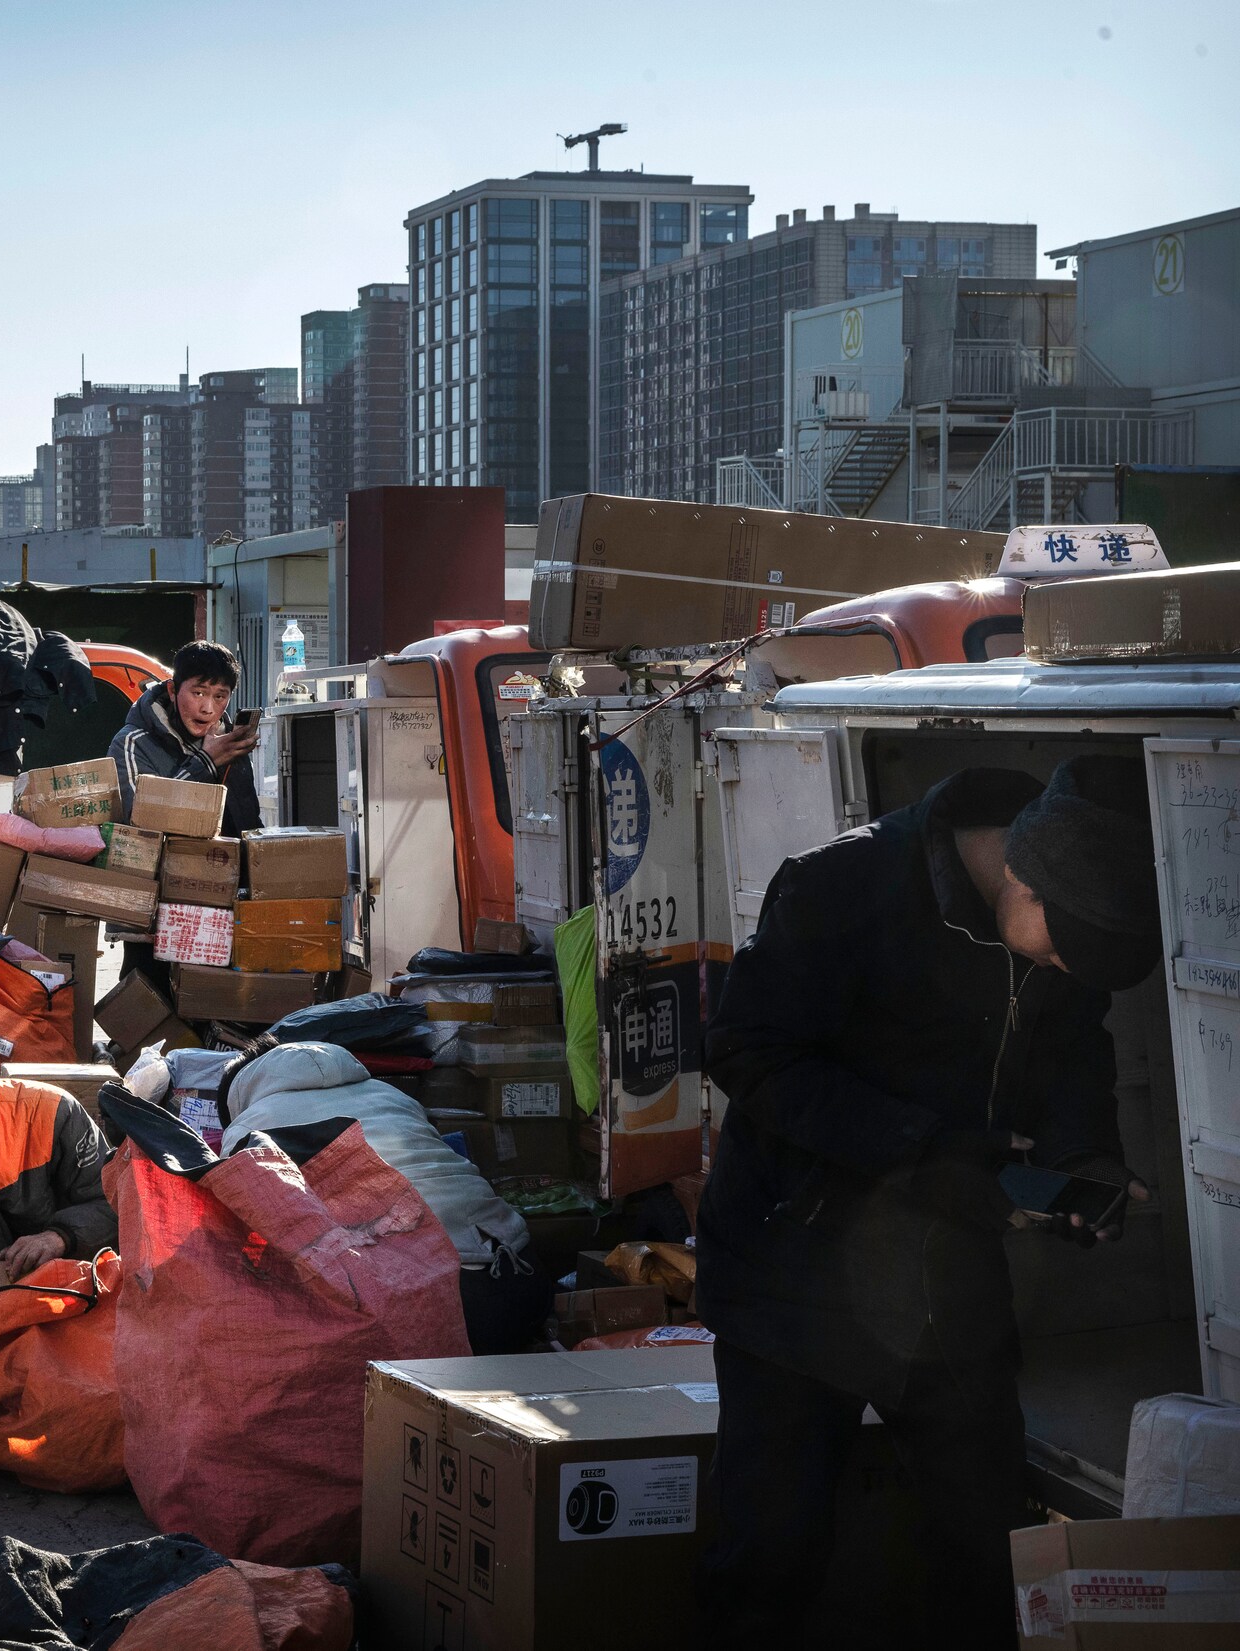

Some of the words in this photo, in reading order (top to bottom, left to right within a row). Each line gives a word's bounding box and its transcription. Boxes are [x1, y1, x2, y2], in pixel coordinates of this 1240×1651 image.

[1159, 242, 1177, 285] 21
[846, 314, 860, 350] 20
[1044, 533, 1132, 563] 快递
[603, 768, 640, 858] 递
[625, 999, 675, 1063] 申通
[643, 1059, 677, 1080] express
[581, 1469, 604, 1477] P9217
[628, 1518, 645, 1527] MAX
